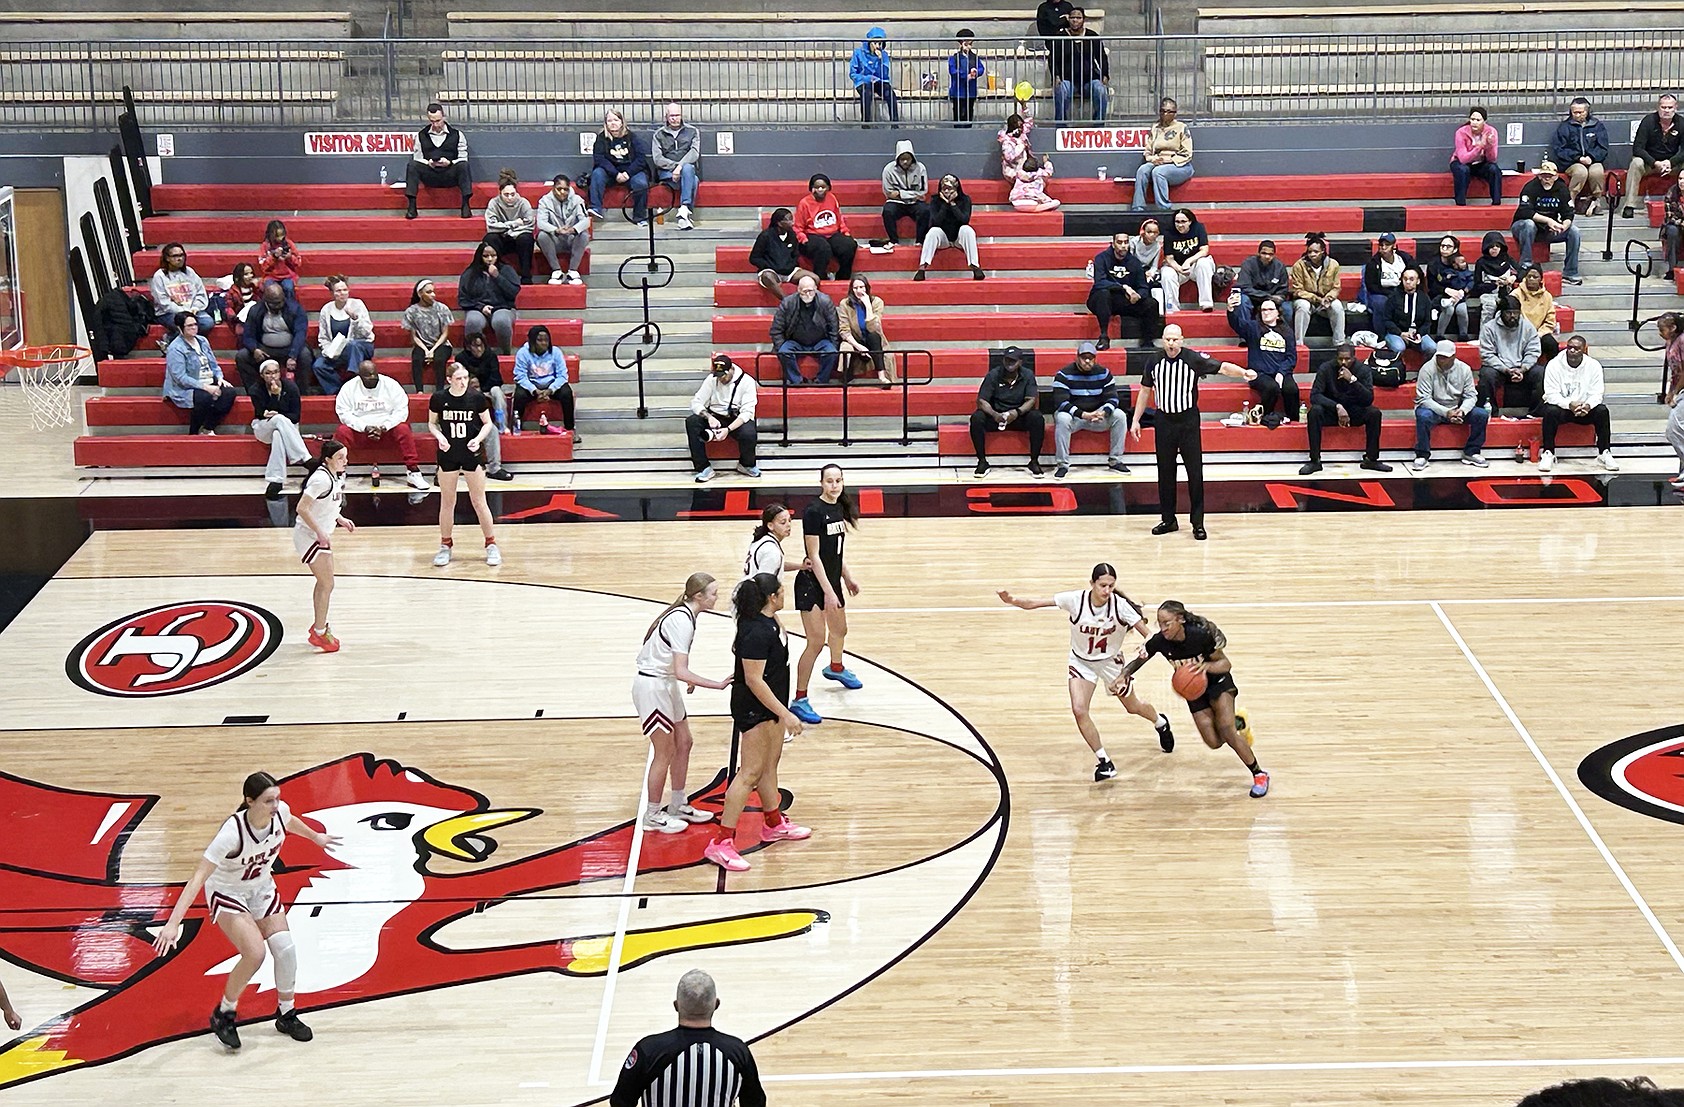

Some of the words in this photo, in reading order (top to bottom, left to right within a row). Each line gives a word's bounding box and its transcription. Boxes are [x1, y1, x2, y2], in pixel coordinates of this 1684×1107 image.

[309, 134, 363, 153] VISITOR
[366, 134, 415, 153] SEATIN
[1060, 130, 1113, 149] VISITOR
[1115, 130, 1151, 148] SEAT
[442, 409, 474, 422] BATTLE
[449, 422, 467, 439] 10
[826, 520, 845, 536] BATT
[837, 534, 843, 555] 1
[1079, 624, 1100, 636] LADY
[1087, 636, 1108, 655] 14
